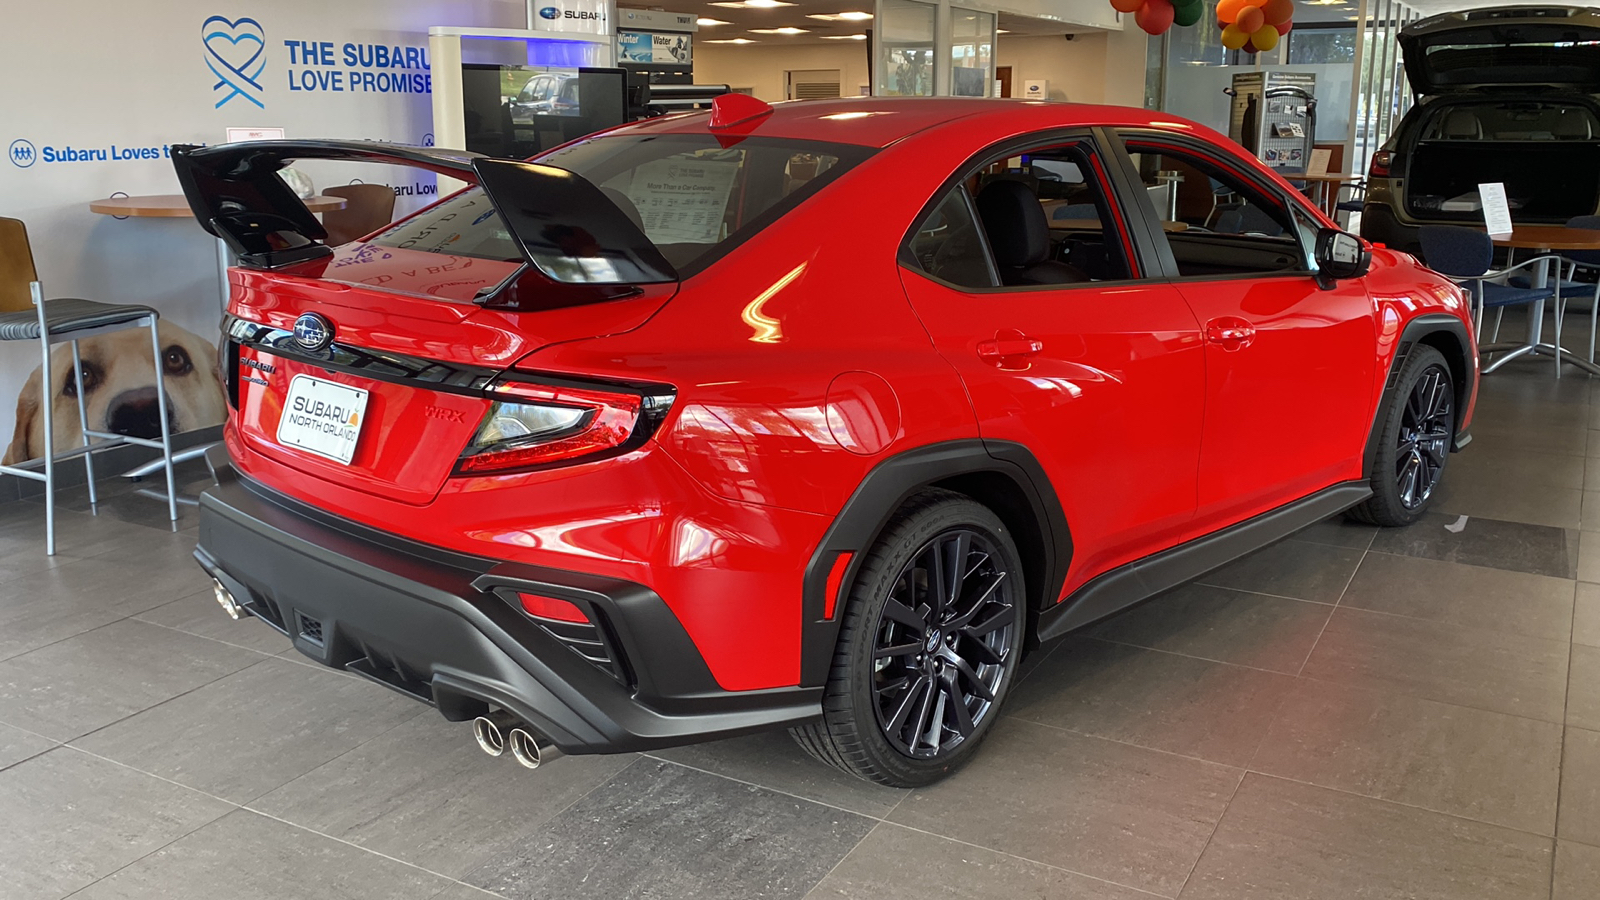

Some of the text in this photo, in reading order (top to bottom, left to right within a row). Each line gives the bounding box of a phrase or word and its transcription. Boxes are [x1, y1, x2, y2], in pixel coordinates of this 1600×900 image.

[617, 33, 639, 44] Winter
[653, 36, 671, 46] Water
[284, 40, 430, 69] THE SUBARU
[288, 69, 432, 93] LOVE PROMISE
[42, 146, 107, 162] Subaru
[111, 145, 160, 161] Loves
[416, 183, 437, 195] Lov
[646, 182, 662, 190] More
[240, 357, 276, 374] SUBARU
[293, 396, 350, 424] SUBARU
[425, 405, 466, 424] WRX
[289, 413, 356, 442] NORTH ORLANDO
[873, 553, 901, 601] MAXX
[903, 533, 917, 550] GT
